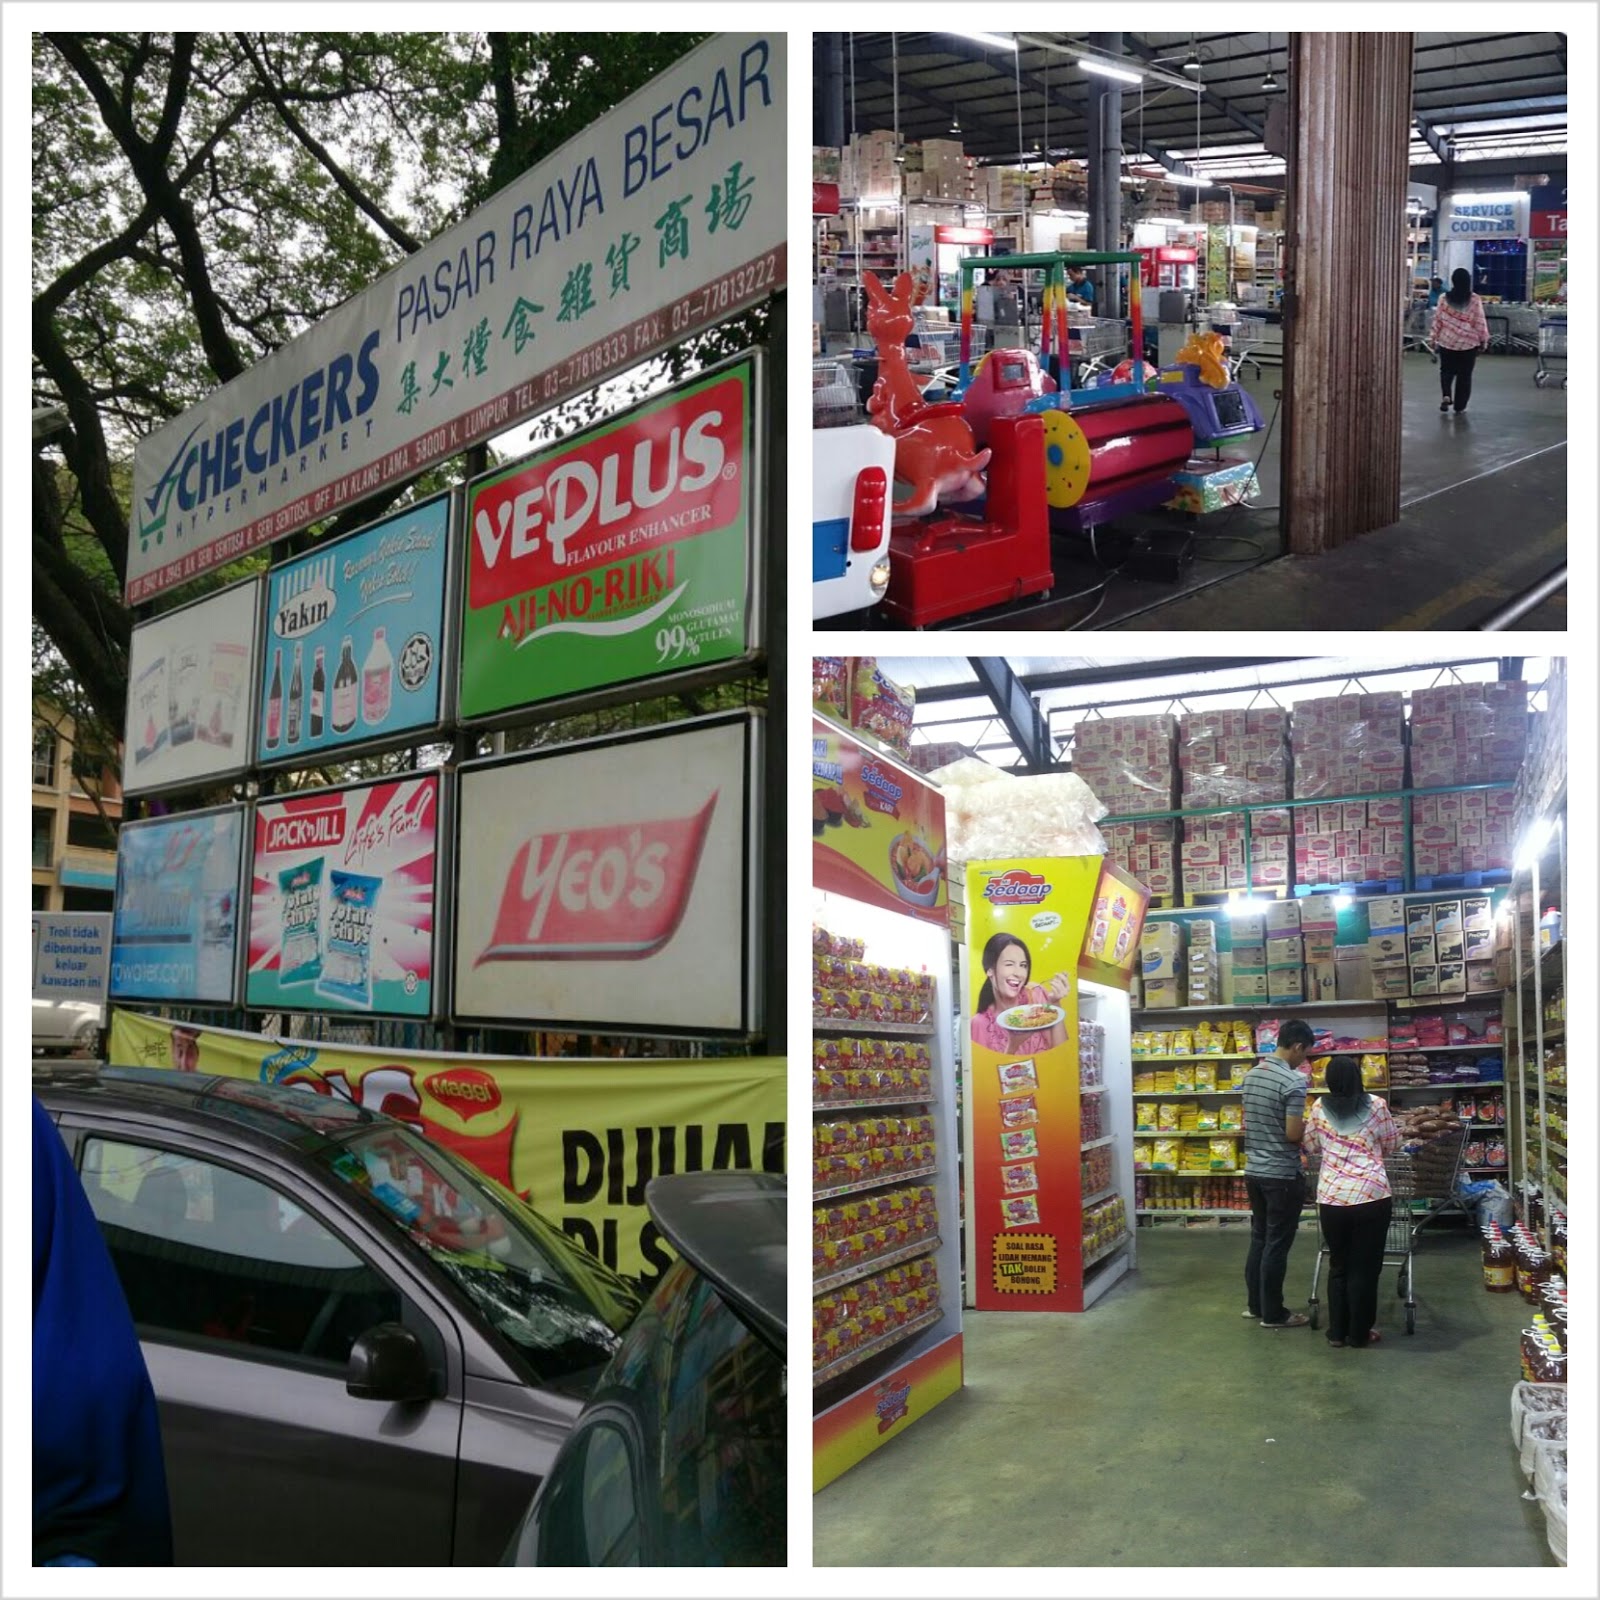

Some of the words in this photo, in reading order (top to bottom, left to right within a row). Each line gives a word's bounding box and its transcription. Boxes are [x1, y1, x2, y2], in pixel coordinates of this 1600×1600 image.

[397, 230, 496, 343] PASAR
[510, 157, 604, 269] RAYA
[623, 40, 772, 199] BESAR
[1454, 204, 1513, 217] SERVICE
[1451, 219, 1515, 233] COUNTER
[350, 462, 380, 492] KLANG
[415, 429, 446, 462] 58000
[464, 398, 509, 438] LUMPUR
[634, 319, 665, 349] FAX:
[177, 329, 380, 511] CHECKERS
[566, 535, 626, 567] FLAVOUR
[629, 505, 711, 545] ENHANCER
[279, 600, 329, 636] Yakin
[860, 765, 903, 801] Sedaap
[983, 880, 1052, 898] Sedaap
[48, 926, 70, 939] Troli
[73, 926, 99, 939] tidak
[44, 943, 103, 956] dibenarkan
[55, 959, 87, 971] keluar
[41, 975, 85, 987] kawasan
[88, 975, 102, 987] ini
[431, 1077, 491, 1102] Maggi
[1006, 1242, 1024, 1250] SOAL
[1021, 1254, 1052, 1262] MEMANG
[1002, 1263, 1022, 1274] TAK
[1024, 1265, 1046, 1273] BOLEH
